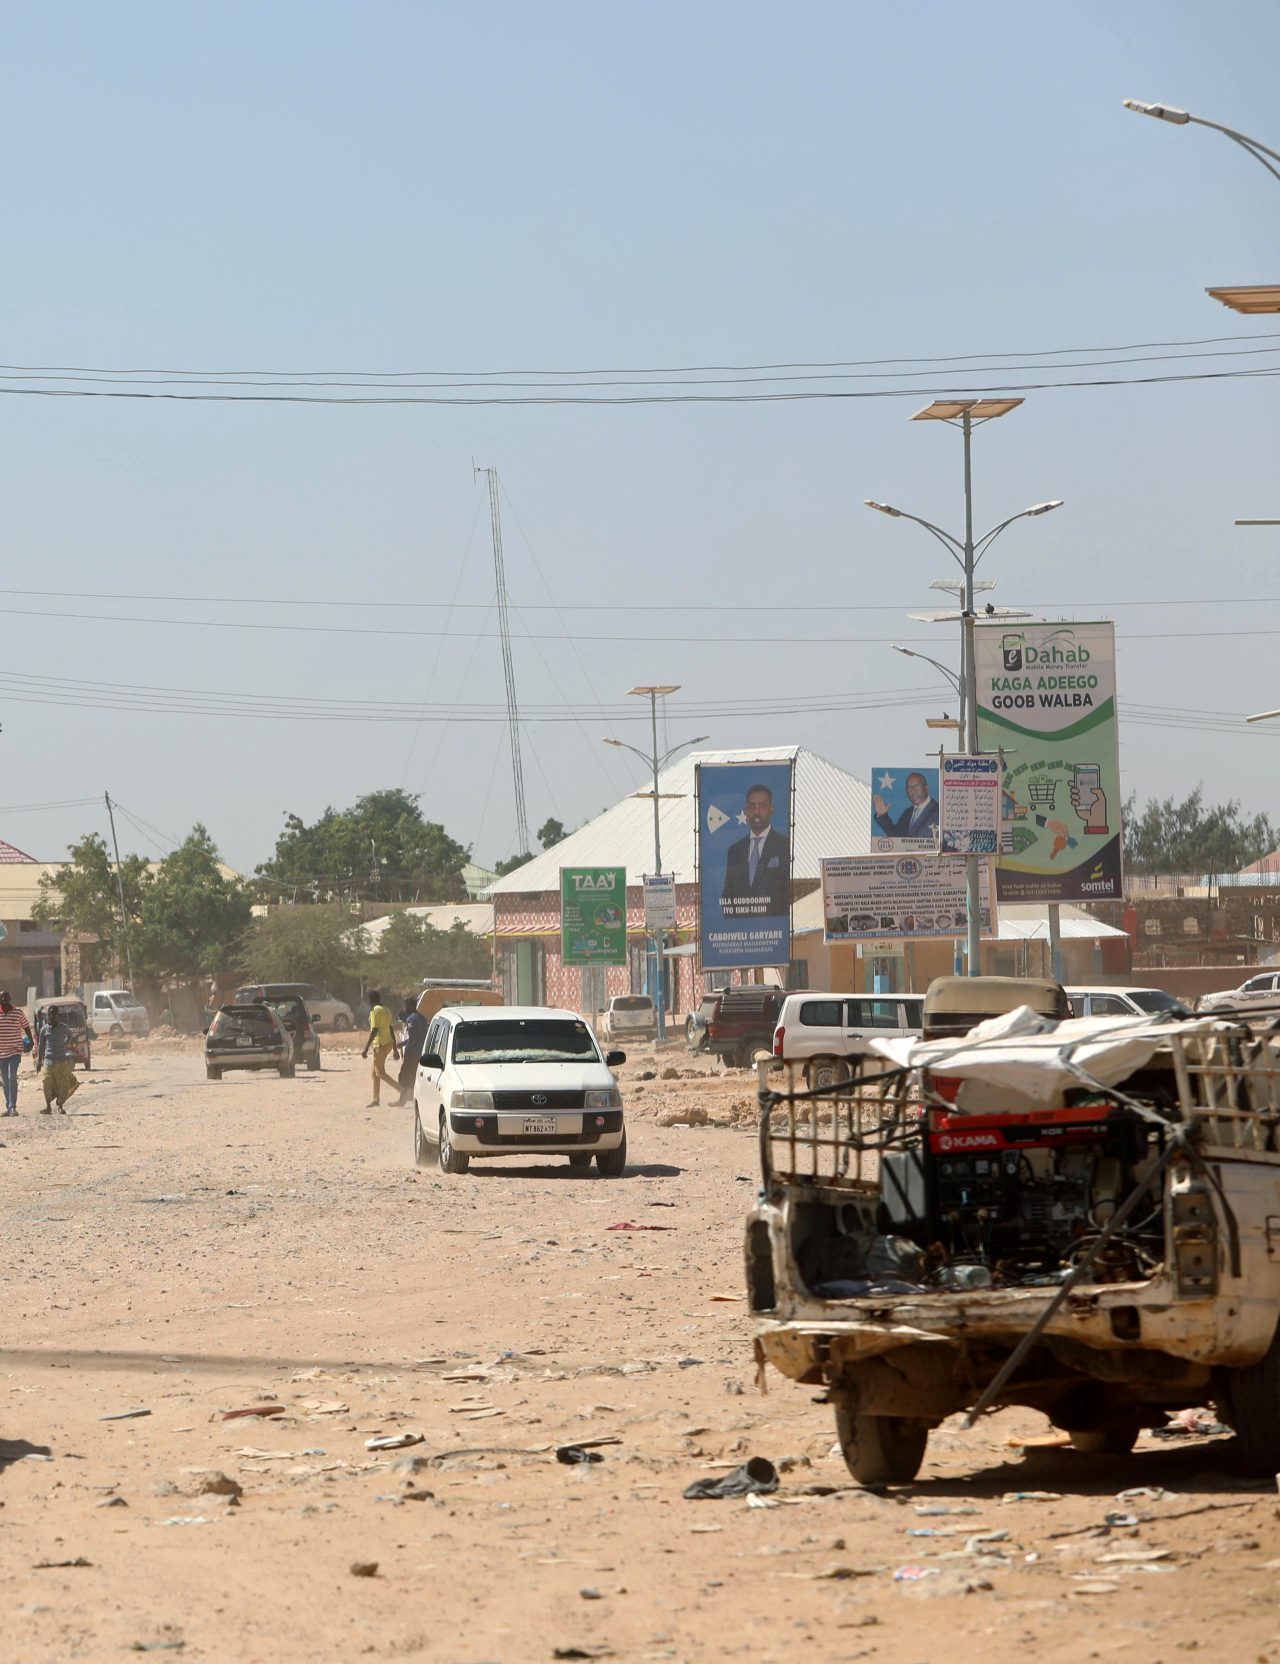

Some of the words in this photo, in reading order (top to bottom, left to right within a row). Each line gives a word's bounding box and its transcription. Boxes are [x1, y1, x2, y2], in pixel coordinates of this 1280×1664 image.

[1025, 645, 1090, 664] Dahab
[991, 676, 1032, 691] KAGA
[1037, 675, 1098, 690] ADEEGO
[992, 694, 1035, 709] GOOB
[1039, 692, 1093, 707] WALBA
[572, 872, 616, 891] TAAJ
[1081, 878, 1114, 892] somtel
[719, 897, 732, 906] ISLA
[733, 896, 771, 904] GUDDOOMIN
[723, 906, 733, 914] IYO
[708, 932, 747, 941] CABDIWELI
[750, 930, 783, 940] GARYARE
[954, 1135, 997, 1148] KAMA
